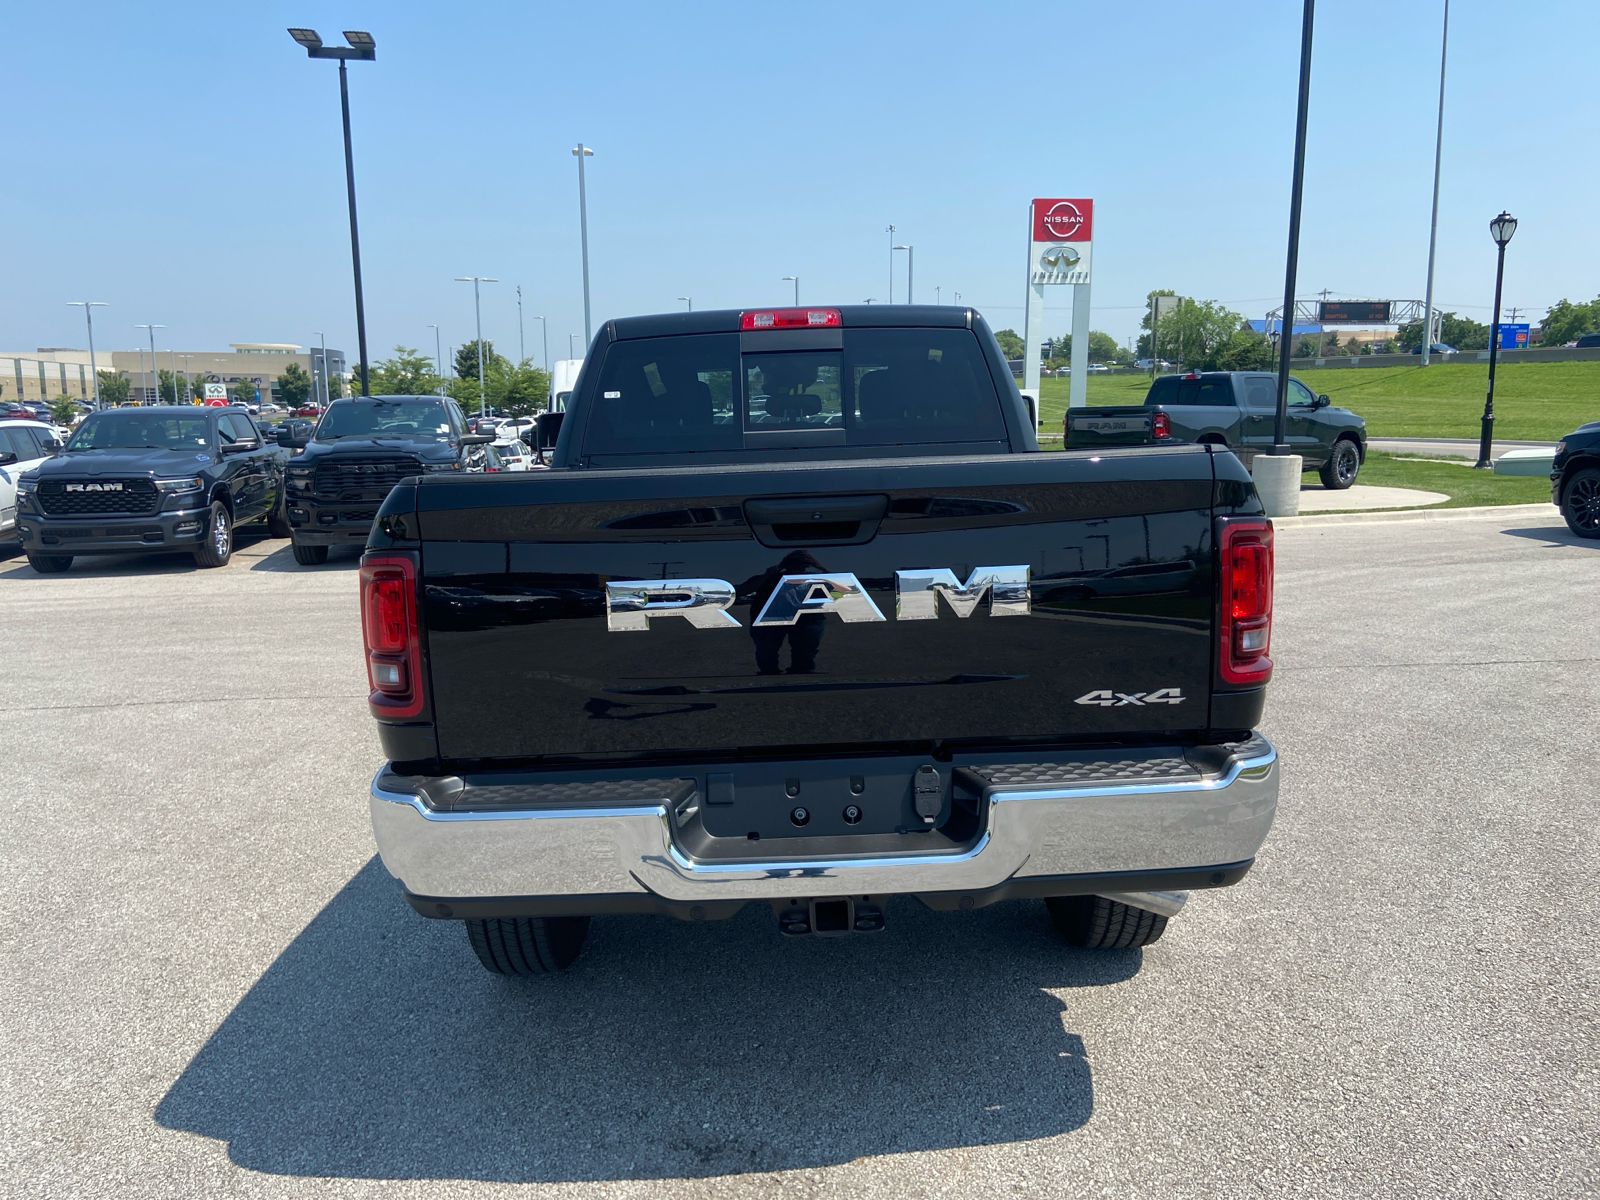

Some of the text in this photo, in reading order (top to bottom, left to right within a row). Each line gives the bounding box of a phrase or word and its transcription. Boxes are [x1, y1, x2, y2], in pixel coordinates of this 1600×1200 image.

[1033, 271, 1089, 280] INFINITI
[1087, 422, 1127, 430] RAM
[339, 465, 396, 474] RAM
[66, 483, 123, 492] RAM
[605, 564, 1032, 632] RAM
[1074, 687, 1187, 706] 4x4
